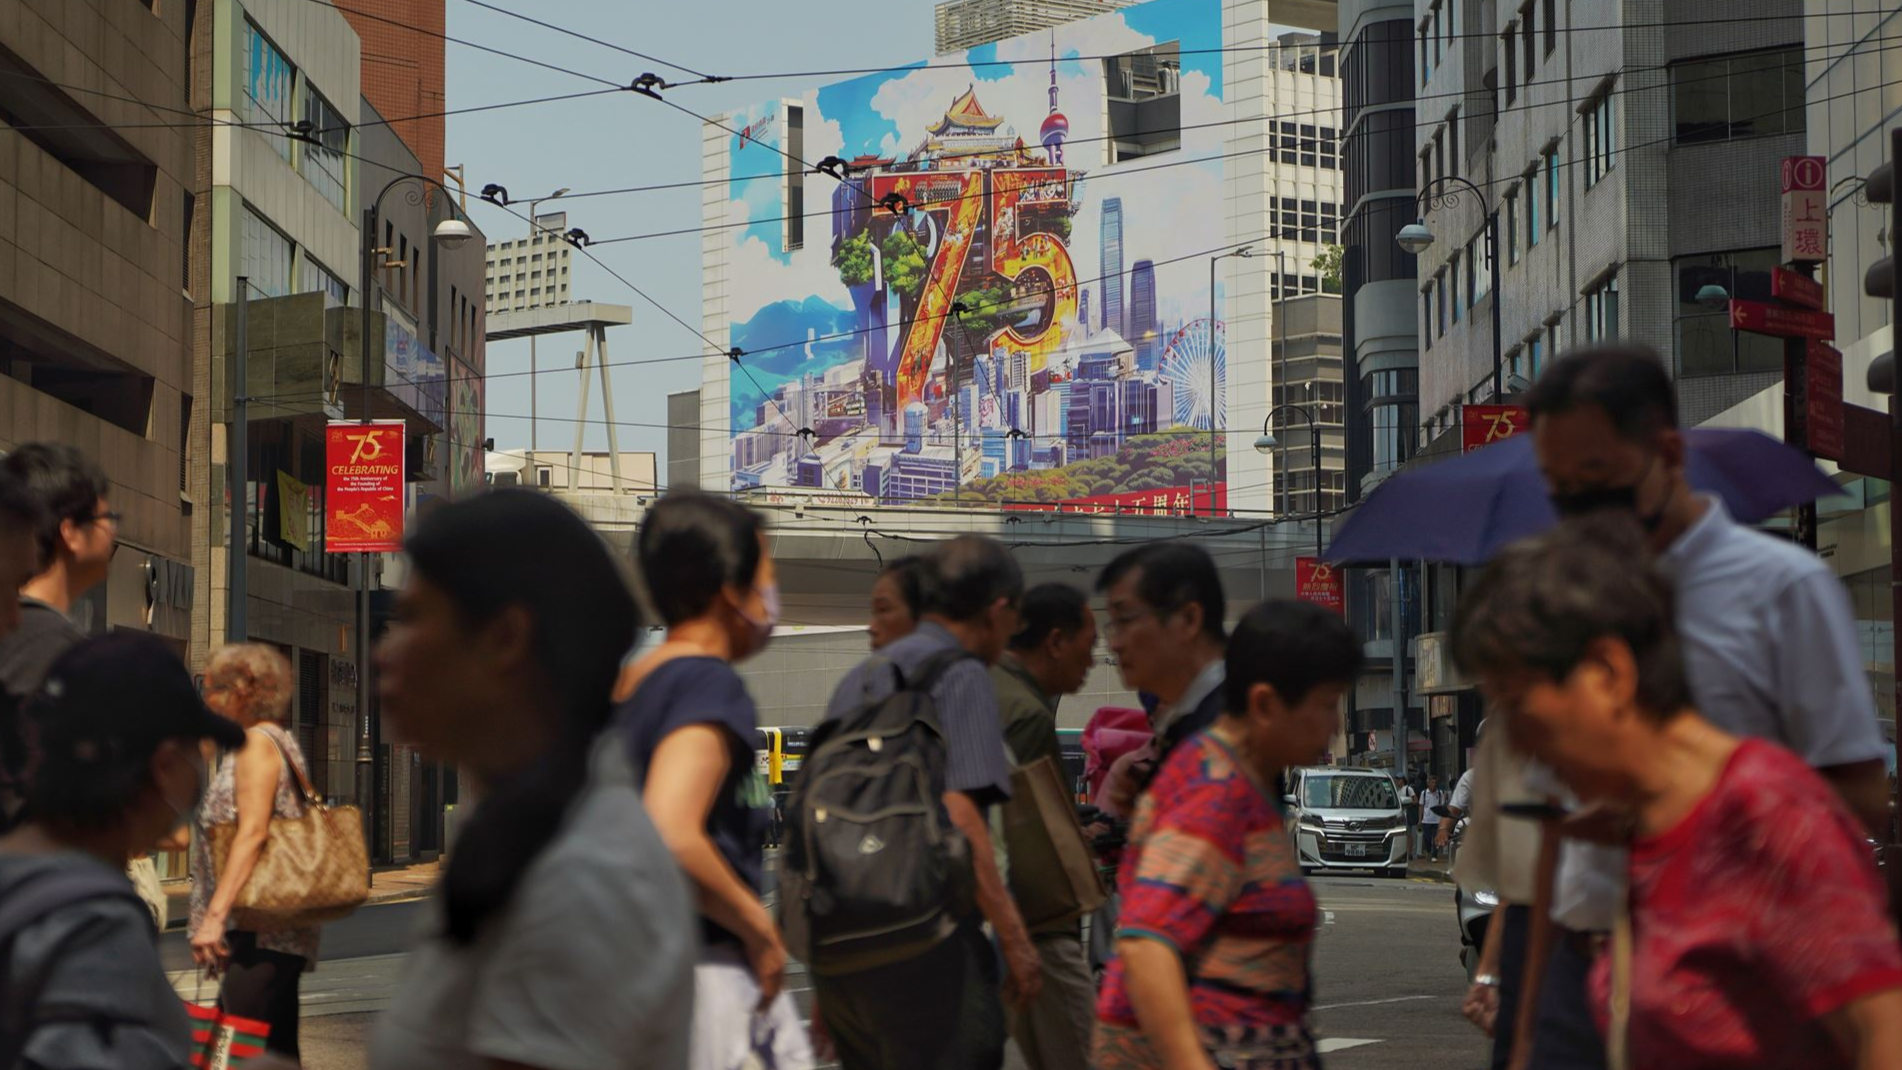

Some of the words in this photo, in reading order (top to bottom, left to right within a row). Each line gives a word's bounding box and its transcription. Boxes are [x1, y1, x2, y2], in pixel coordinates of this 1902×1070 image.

[1795, 198, 1822, 254] 上環
[872, 168, 1079, 403] 75
[1481, 410, 1517, 443] 75
[346, 430, 384, 464] 75
[331, 465, 399, 475] CELEBRATING
[1308, 562, 1331, 582] 75
